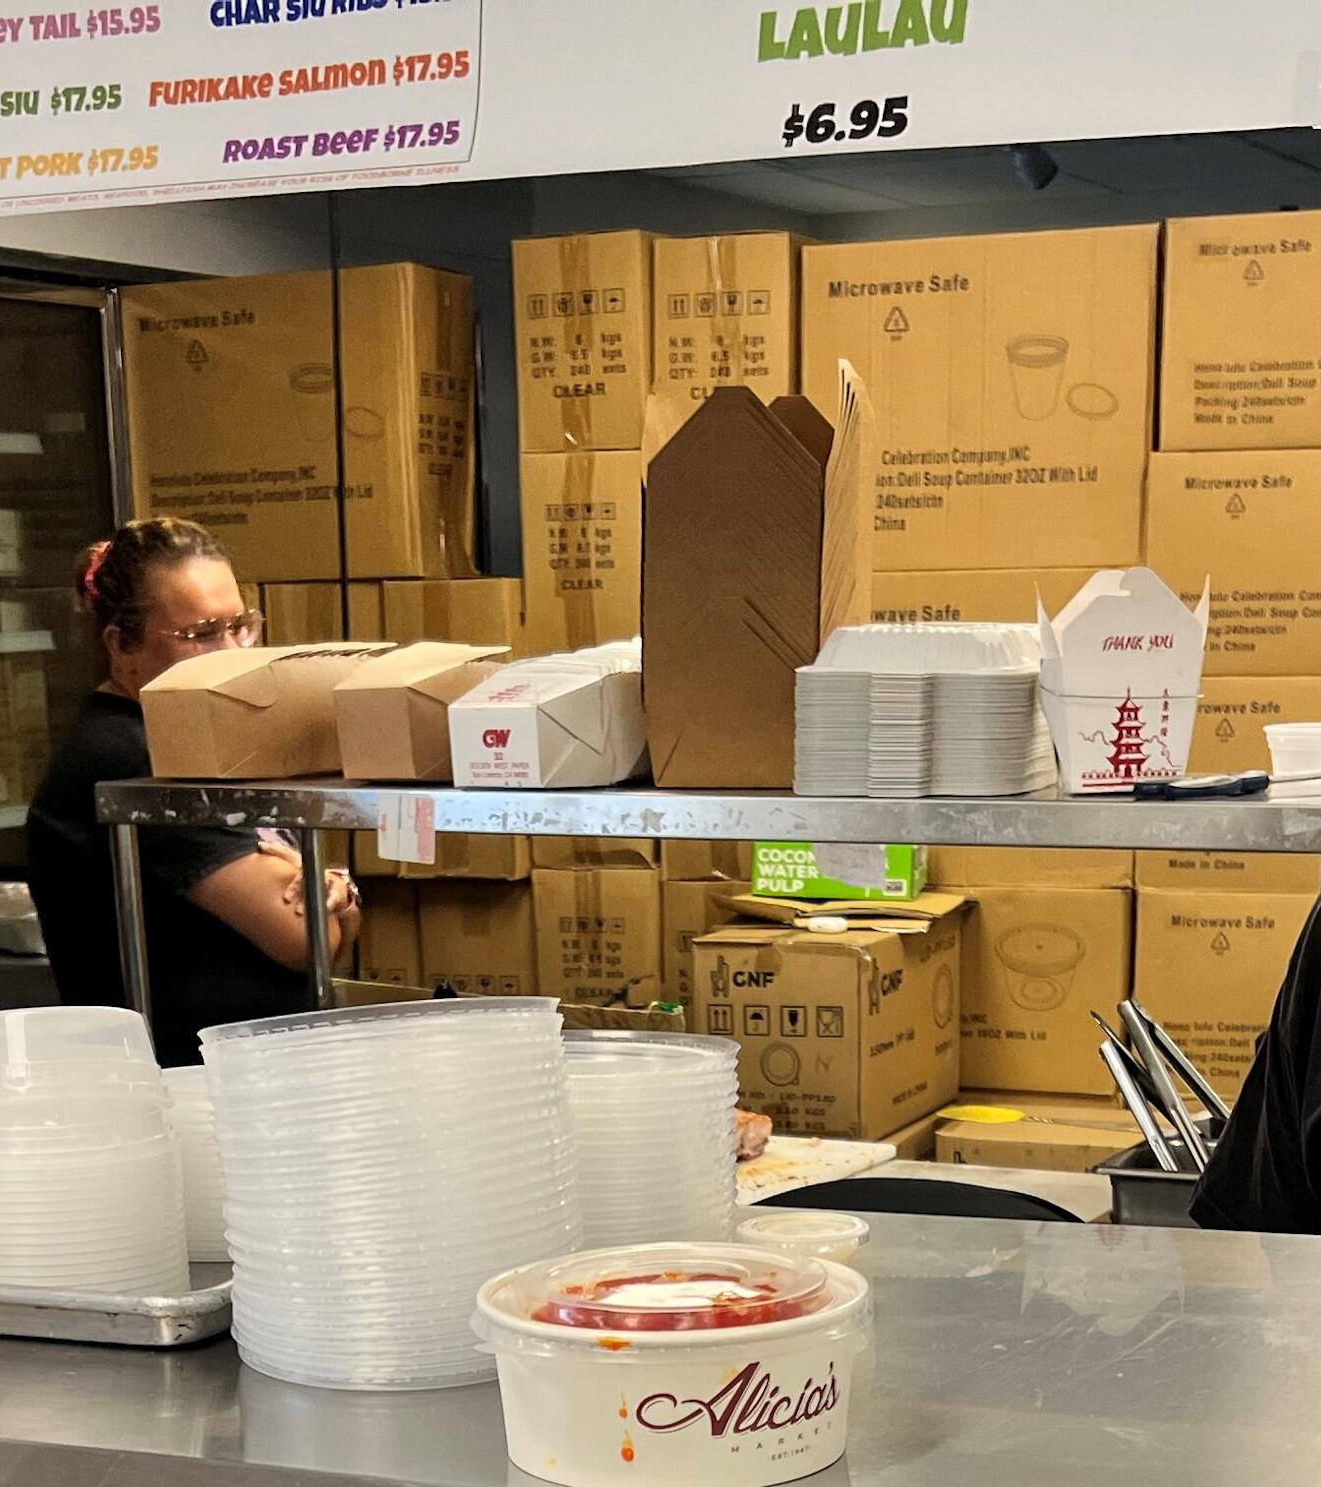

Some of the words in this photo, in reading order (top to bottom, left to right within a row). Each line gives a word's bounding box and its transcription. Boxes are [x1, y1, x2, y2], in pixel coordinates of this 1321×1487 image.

[29, 13, 81, 40] TAIL
[86, 6, 161, 39] $15.95
[210, 0, 279, 27] CHAR
[286, 0, 327, 21] SIU
[757, 0, 969, 63] LAULAU
[393, 50, 469, 86] $17.95
[0, 89, 39, 117] SIU
[51, 84, 122, 115] $17.95
[782, 96, 909, 147] $6.95
[223, 135, 308, 163] ROAST
[384, 121, 460, 151] $17.95
[16, 152, 85, 179] PORK
[87, 145, 159, 176] $17.95
[828, 278, 924, 300] Microwave
[929, 274, 970, 295] Safe
[552, 381, 606, 400] CLEAR
[922, 605, 961, 623] Safe
[1102, 635, 1145, 652] THANK
[1149, 635, 1174, 650] YOU
[1197, 702, 1247, 715] rowave
[482, 729, 511, 749] GW
[757, 848, 816, 865] COCON
[1214, 859, 1246, 871] China
[758, 863, 819, 879] WATER
[757, 877, 805, 893] PULP
[1171, 914, 1242, 929] Microwave
[1245, 915, 1276, 929] Safe
[732, 971, 775, 989] CNF
[636, 1361, 840, 1438] Alicia's
